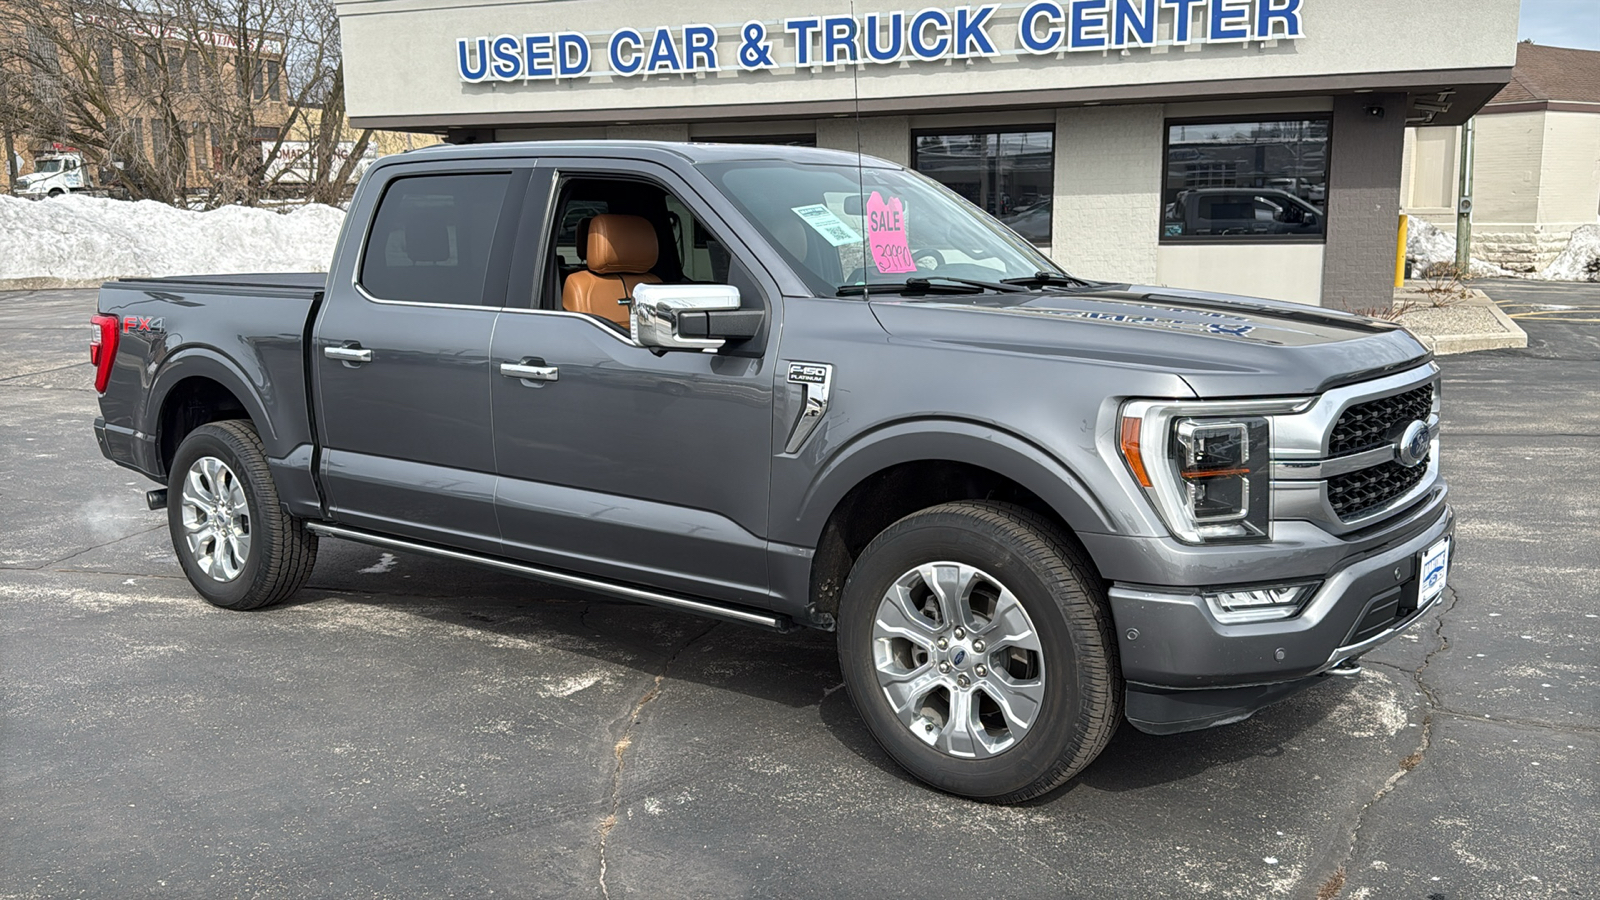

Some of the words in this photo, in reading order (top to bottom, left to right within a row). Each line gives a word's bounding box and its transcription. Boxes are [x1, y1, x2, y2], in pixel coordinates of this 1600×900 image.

[456, 30, 591, 83] USED
[607, 22, 722, 77] CAR
[738, 20, 780, 71] &
[785, 4, 1000, 67] TRUCK
[1018, 0, 1306, 55] CENTER
[870, 210, 901, 232] SALE
[123, 316, 165, 333] FX4
[790, 365, 826, 376] F-150
[790, 374, 823, 382] PLATINUM
